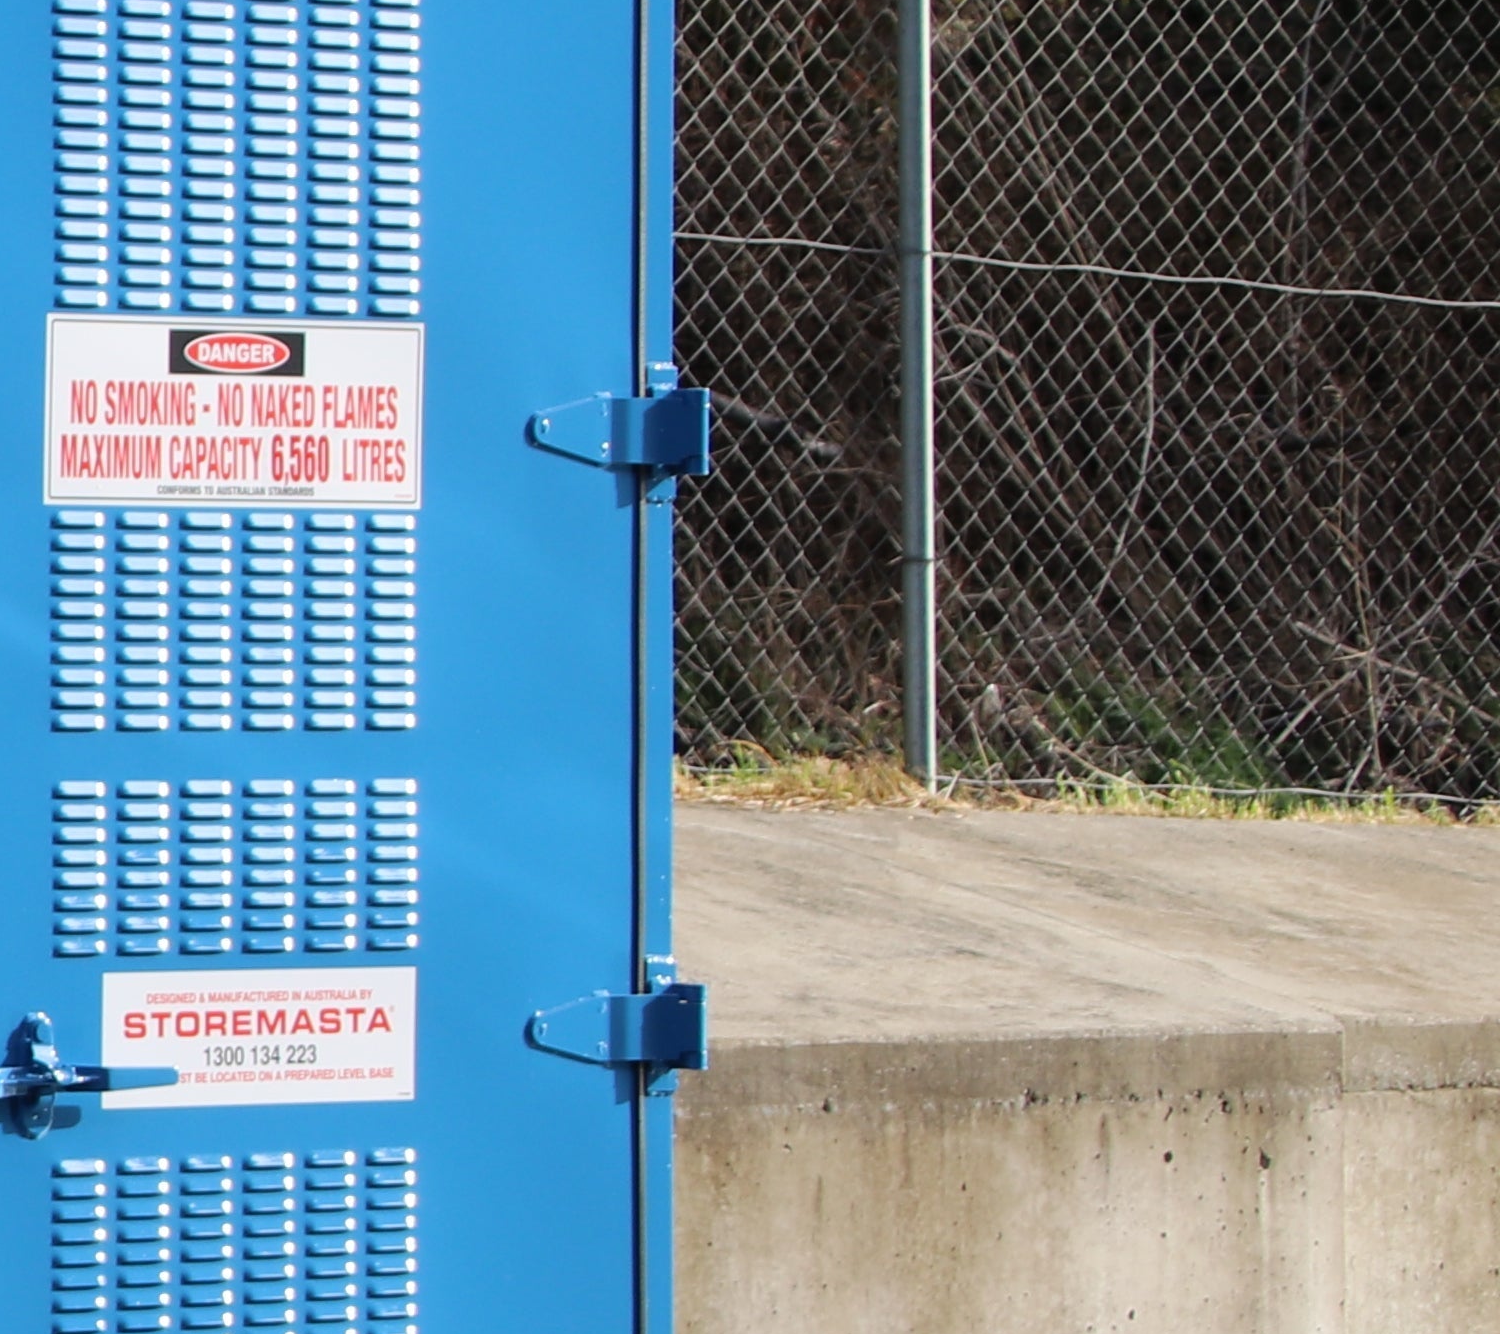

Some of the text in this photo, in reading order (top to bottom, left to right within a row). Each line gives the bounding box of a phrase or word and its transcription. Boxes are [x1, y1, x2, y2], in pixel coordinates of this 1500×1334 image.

[197, 342, 275, 364] DANGER
[71, 379, 97, 425] NO
[105, 380, 196, 426] SMOKING
[218, 382, 244, 427] NO
[251, 383, 315, 428] NAKED
[322, 384, 398, 430] FLAMES
[60, 433, 406, 485] MAXIMUM CAPACITY 6,560 LITRES
[156, 484, 315, 497] CONFORMS TO AUSTRALIAN STANDARDS
[146, 992, 197, 1005] DESIGNED
[208, 989, 289, 1003] MANUFACTURED
[291, 989, 302, 1001] IN
[304, 988, 358, 1001] AUSTRALIA
[360, 988, 374, 1000] BY
[203, 1043, 318, 1067] 1300 134 223
[195, 1071, 208, 1083] BE
[210, 1069, 257, 1083] LOCATED
[258, 1069, 273, 1082] ON
[274, 1069, 282, 1081] A
[284, 1068, 337, 1081] PREPARED
[338, 1067, 367, 1080] LEVEL
[369, 1066, 395, 1079] BASE
